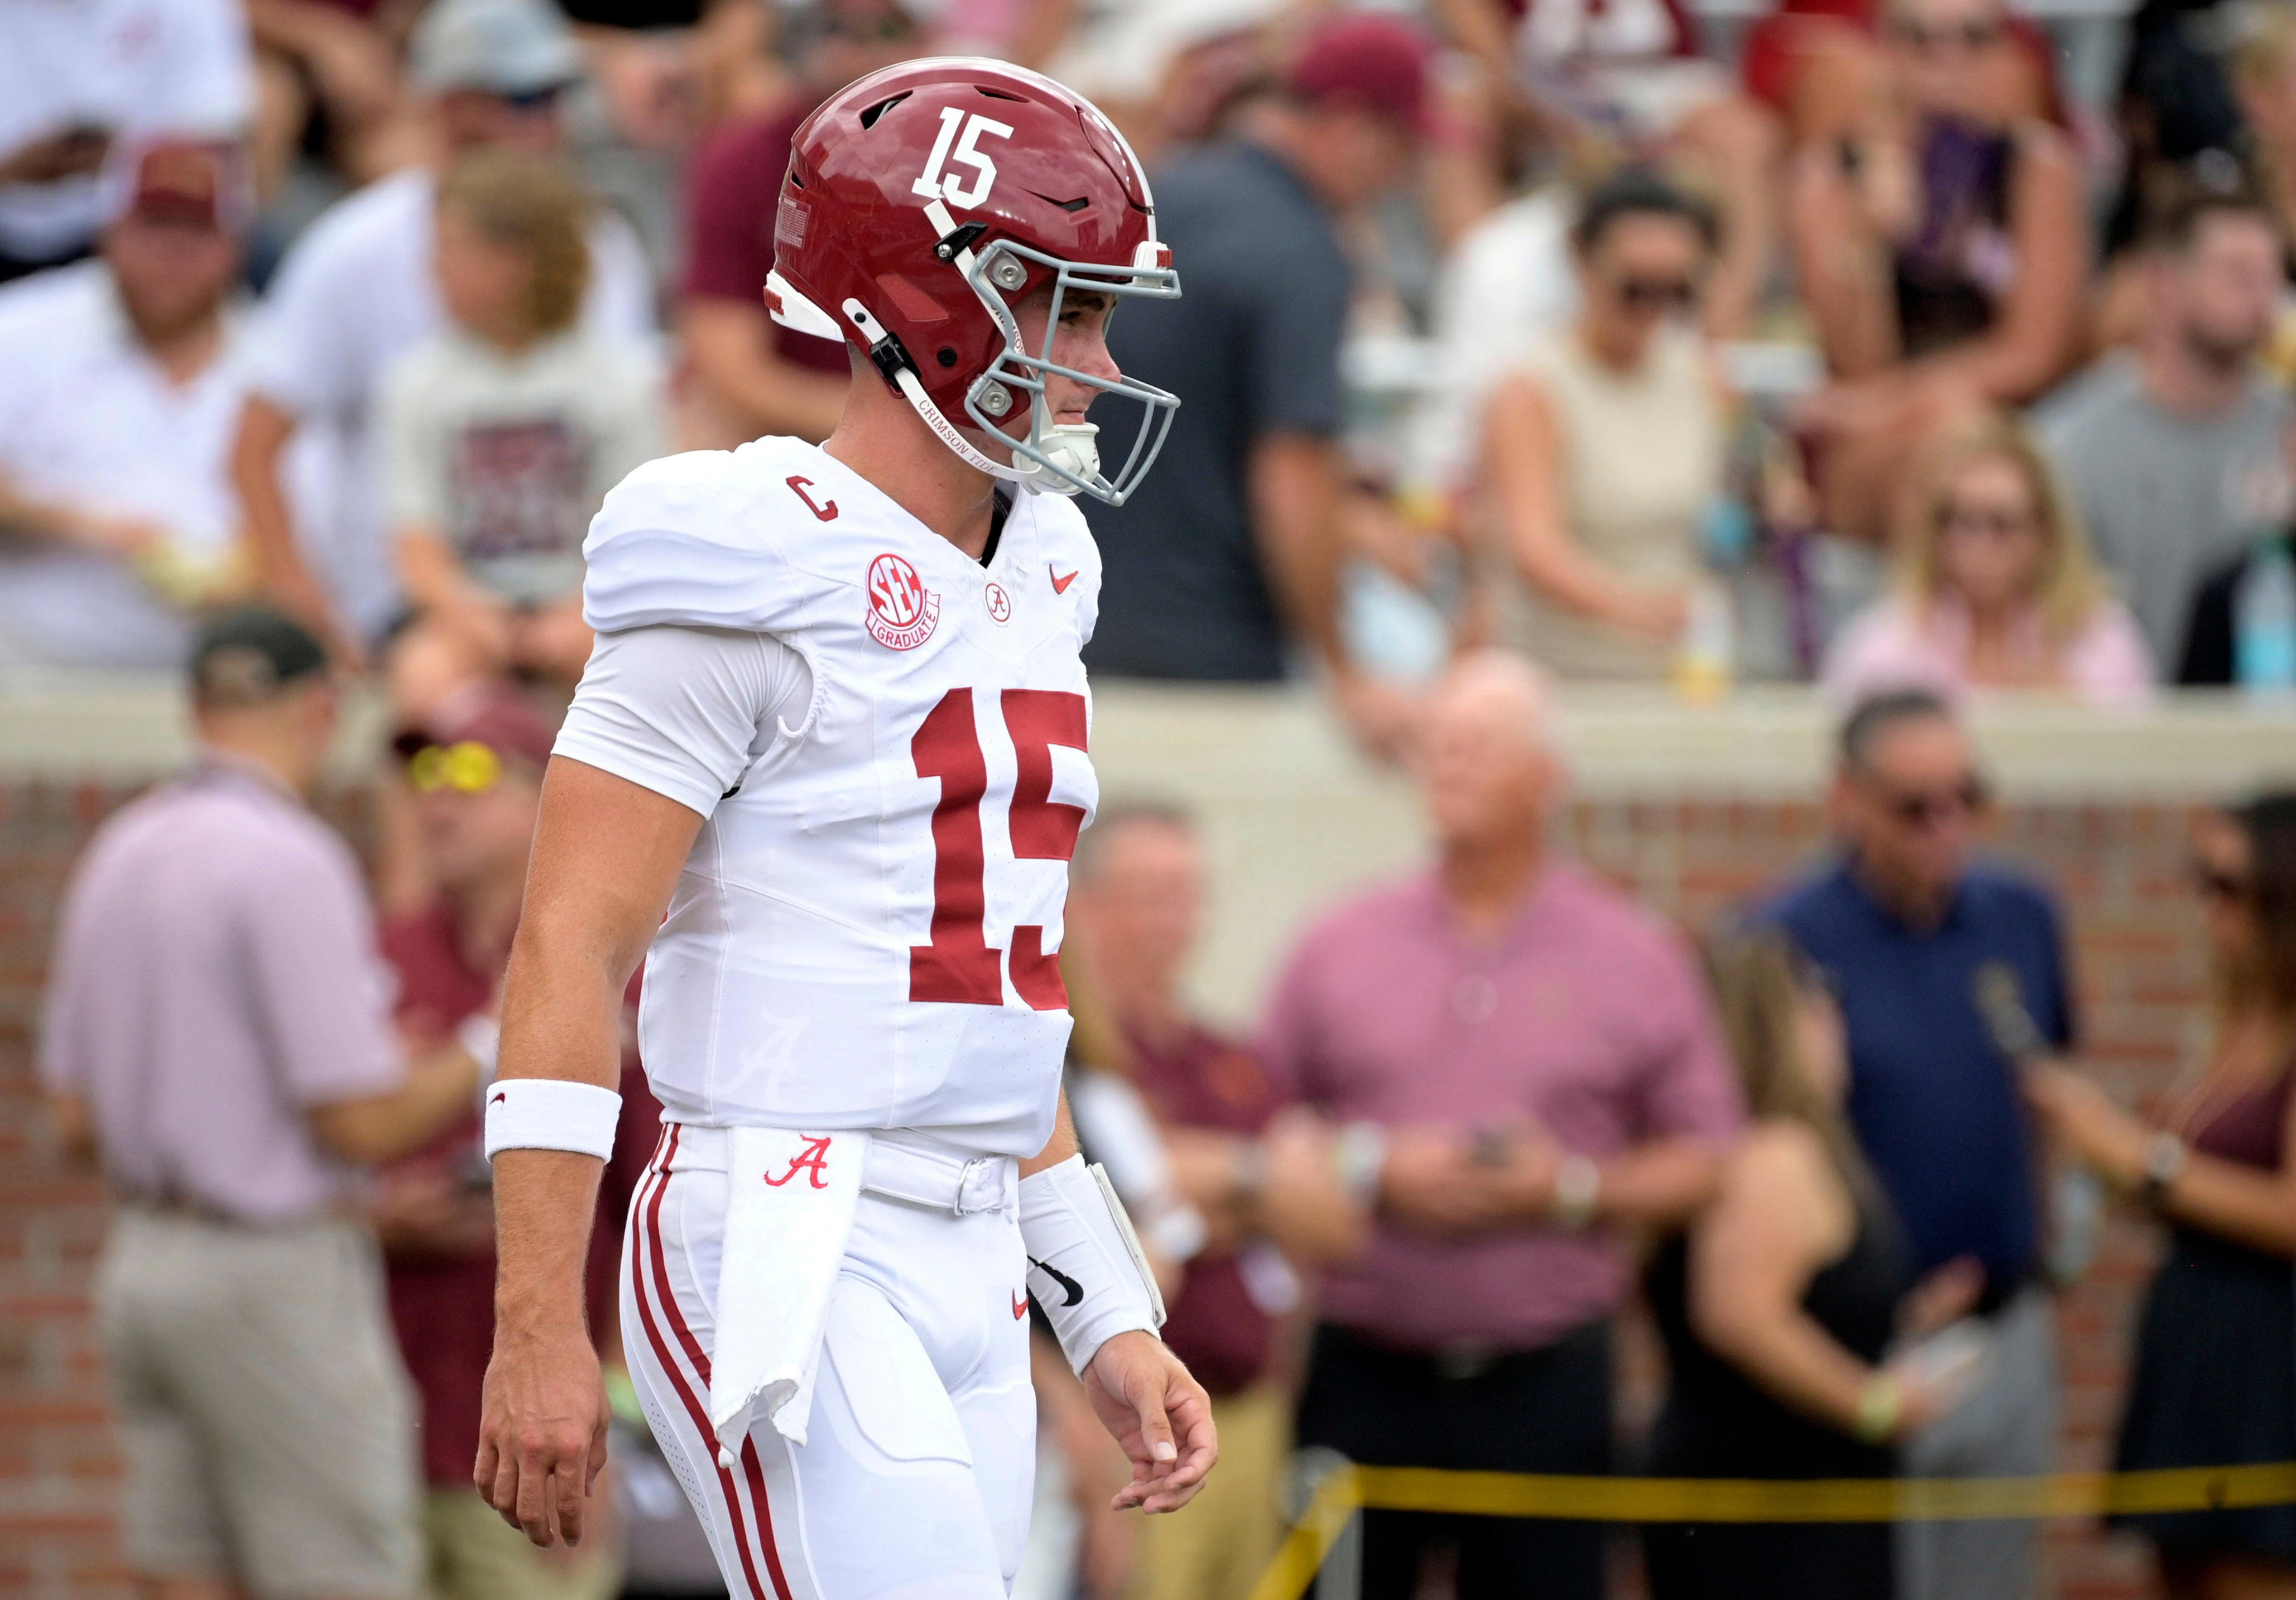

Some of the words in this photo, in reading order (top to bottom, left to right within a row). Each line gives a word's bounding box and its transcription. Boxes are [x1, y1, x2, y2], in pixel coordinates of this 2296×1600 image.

[911, 106, 1014, 210] 15
[919, 400, 969, 454] CRIMSON
[969, 453, 998, 473] TIDE
[785, 475, 838, 522] C
[870, 557, 921, 624] SEC
[877, 610, 936, 647] GRADUATE
[909, 687, 1088, 1010] 15
[763, 1134, 831, 1189] A
